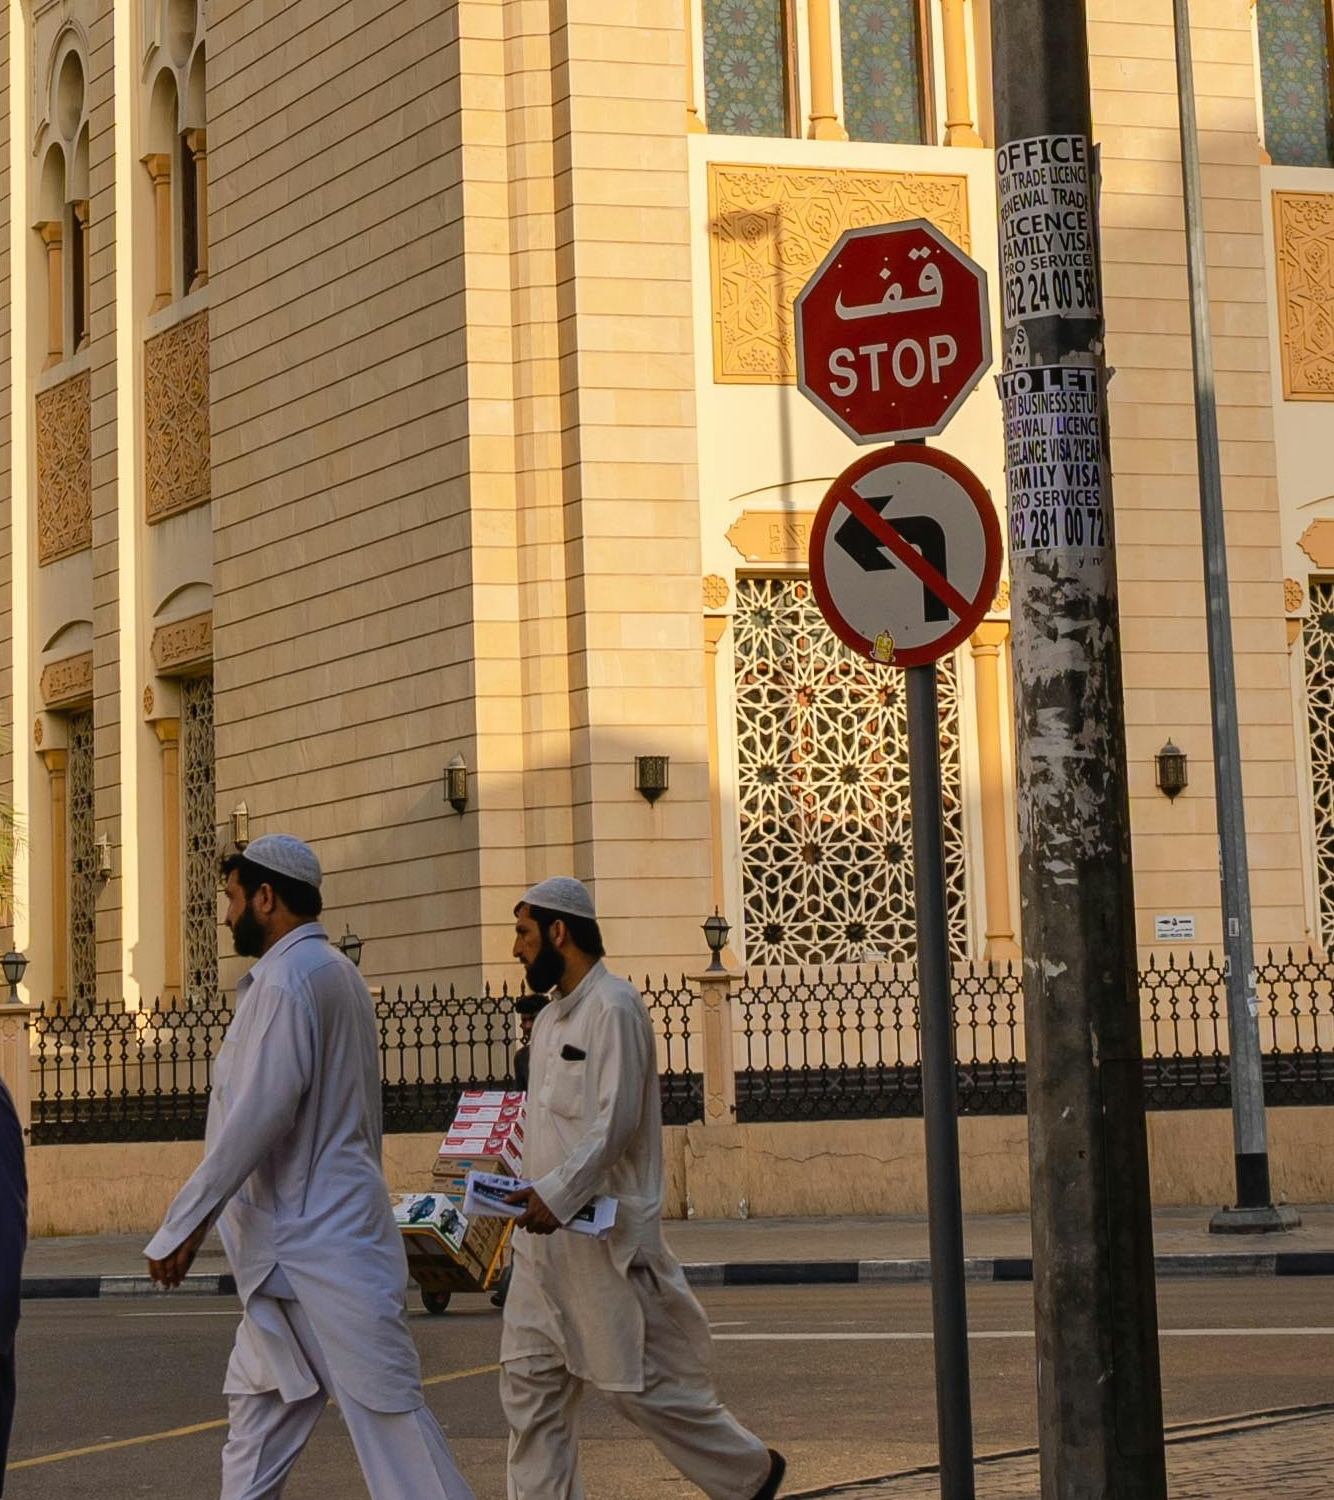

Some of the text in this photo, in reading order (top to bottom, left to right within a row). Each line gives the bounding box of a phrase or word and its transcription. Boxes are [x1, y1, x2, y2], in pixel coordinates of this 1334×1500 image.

[997, 137, 1085, 175] OFFICE
[999, 166, 1087, 195] NEW TRADE LICENCE
[1001, 188, 1088, 224] RENEWAL TRADE
[1005, 211, 1088, 241] LICENCE
[1003, 231, 1092, 264] FAMILY VISA
[1005, 253, 1093, 278] PRO SERVICES
[835, 246, 943, 320] قف
[1006, 276, 1027, 321] 052
[1028, 271, 1050, 312] 24
[1053, 269, 1072, 310] 00
[828, 333, 958, 398] STOP
[1004, 369, 1096, 397] TO LET
[1018, 393, 1067, 416] BUSINESS
[1069, 393, 1098, 414] SETUP
[1006, 418, 1047, 441] RENEWAL
[1056, 416, 1099, 437] LICENCE
[1007, 440, 1047, 467] FREELANCE
[1049, 440, 1072, 462] VISA
[1010, 464, 1101, 493] FAMILY VISA
[1012, 489, 1100, 510] PRO SERVICES
[1010, 507, 1105, 551] 052 281 00 72
